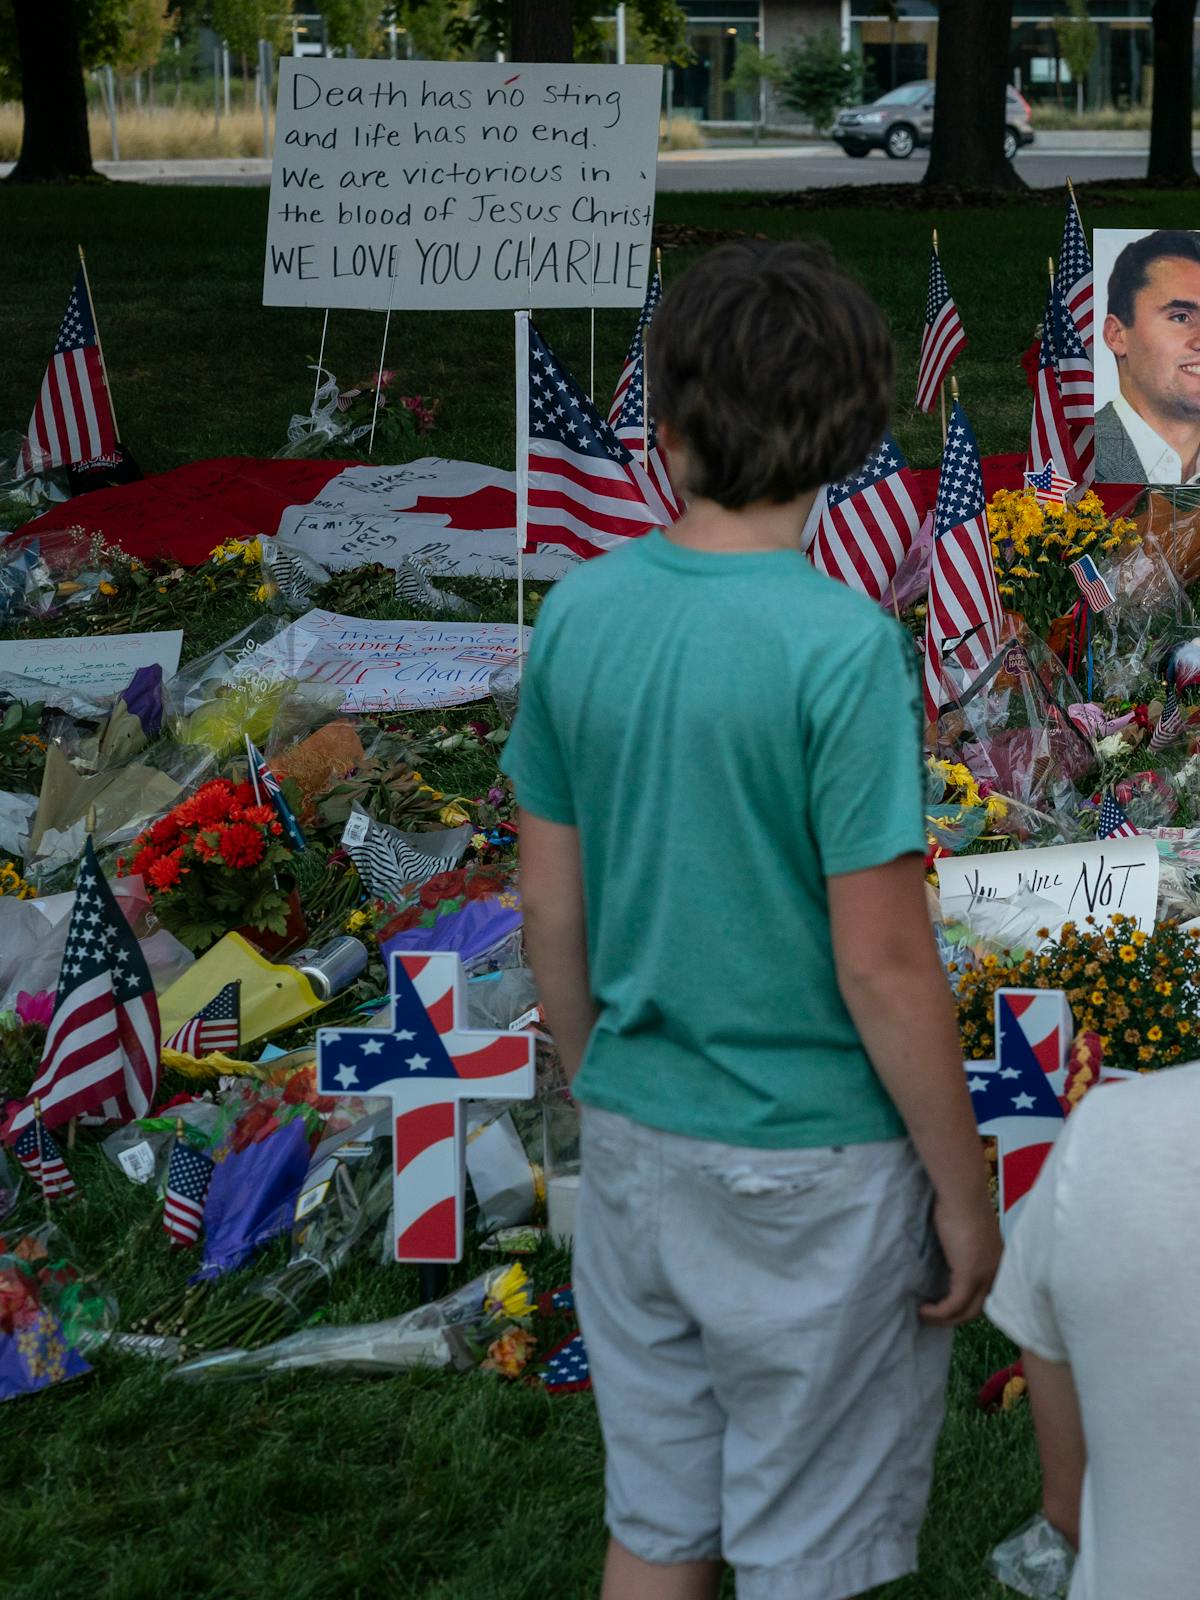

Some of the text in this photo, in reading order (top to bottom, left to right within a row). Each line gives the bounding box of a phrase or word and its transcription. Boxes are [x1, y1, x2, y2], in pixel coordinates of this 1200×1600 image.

[293, 73, 621, 128] Death has no sting
[285, 122, 597, 149] and life has no end.
[282, 161, 611, 190] We are victorious in
[278, 194, 652, 227] the blood of Jesus Christ
[271, 238, 644, 289] WE LOVE YOU CHARLIE
[1067, 855, 1146, 914] NOT
